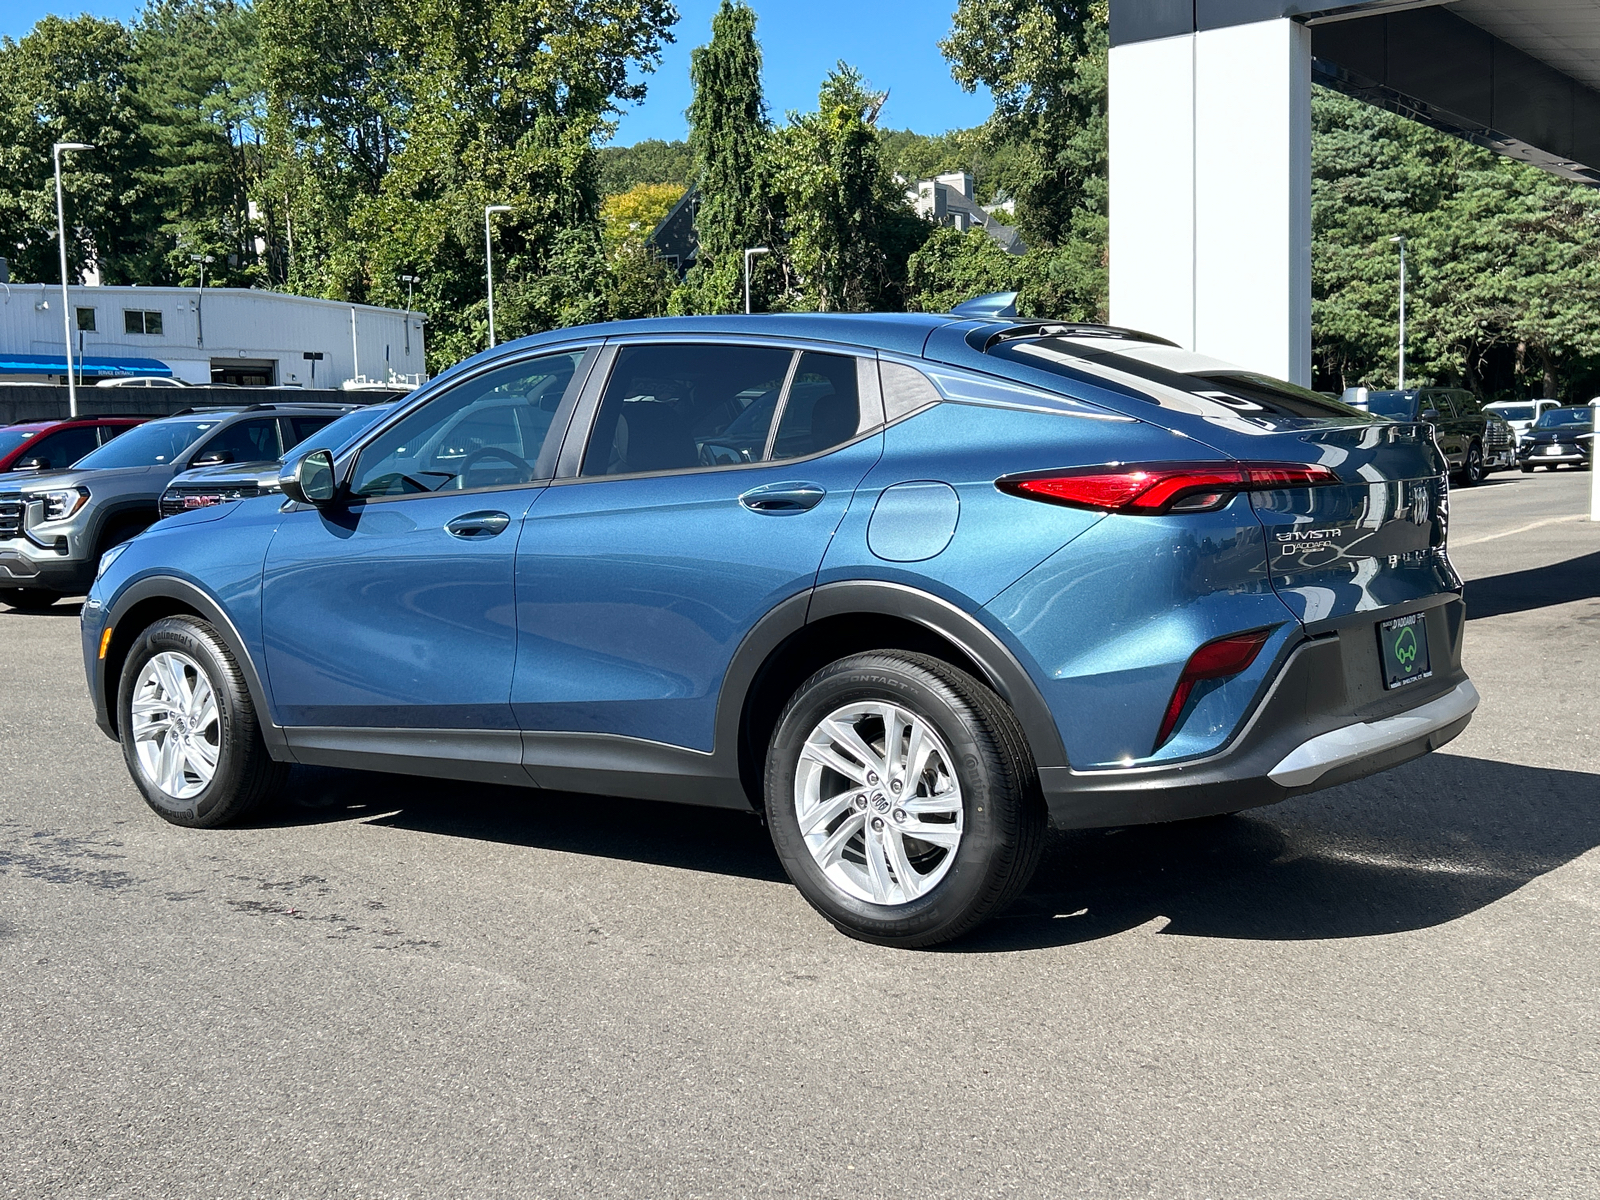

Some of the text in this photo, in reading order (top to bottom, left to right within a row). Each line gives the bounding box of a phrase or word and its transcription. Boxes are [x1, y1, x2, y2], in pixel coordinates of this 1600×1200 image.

[184, 495, 220, 508] GMC
[1276, 528, 1341, 541] ENVISTA
[150, 630, 188, 645] Continental
